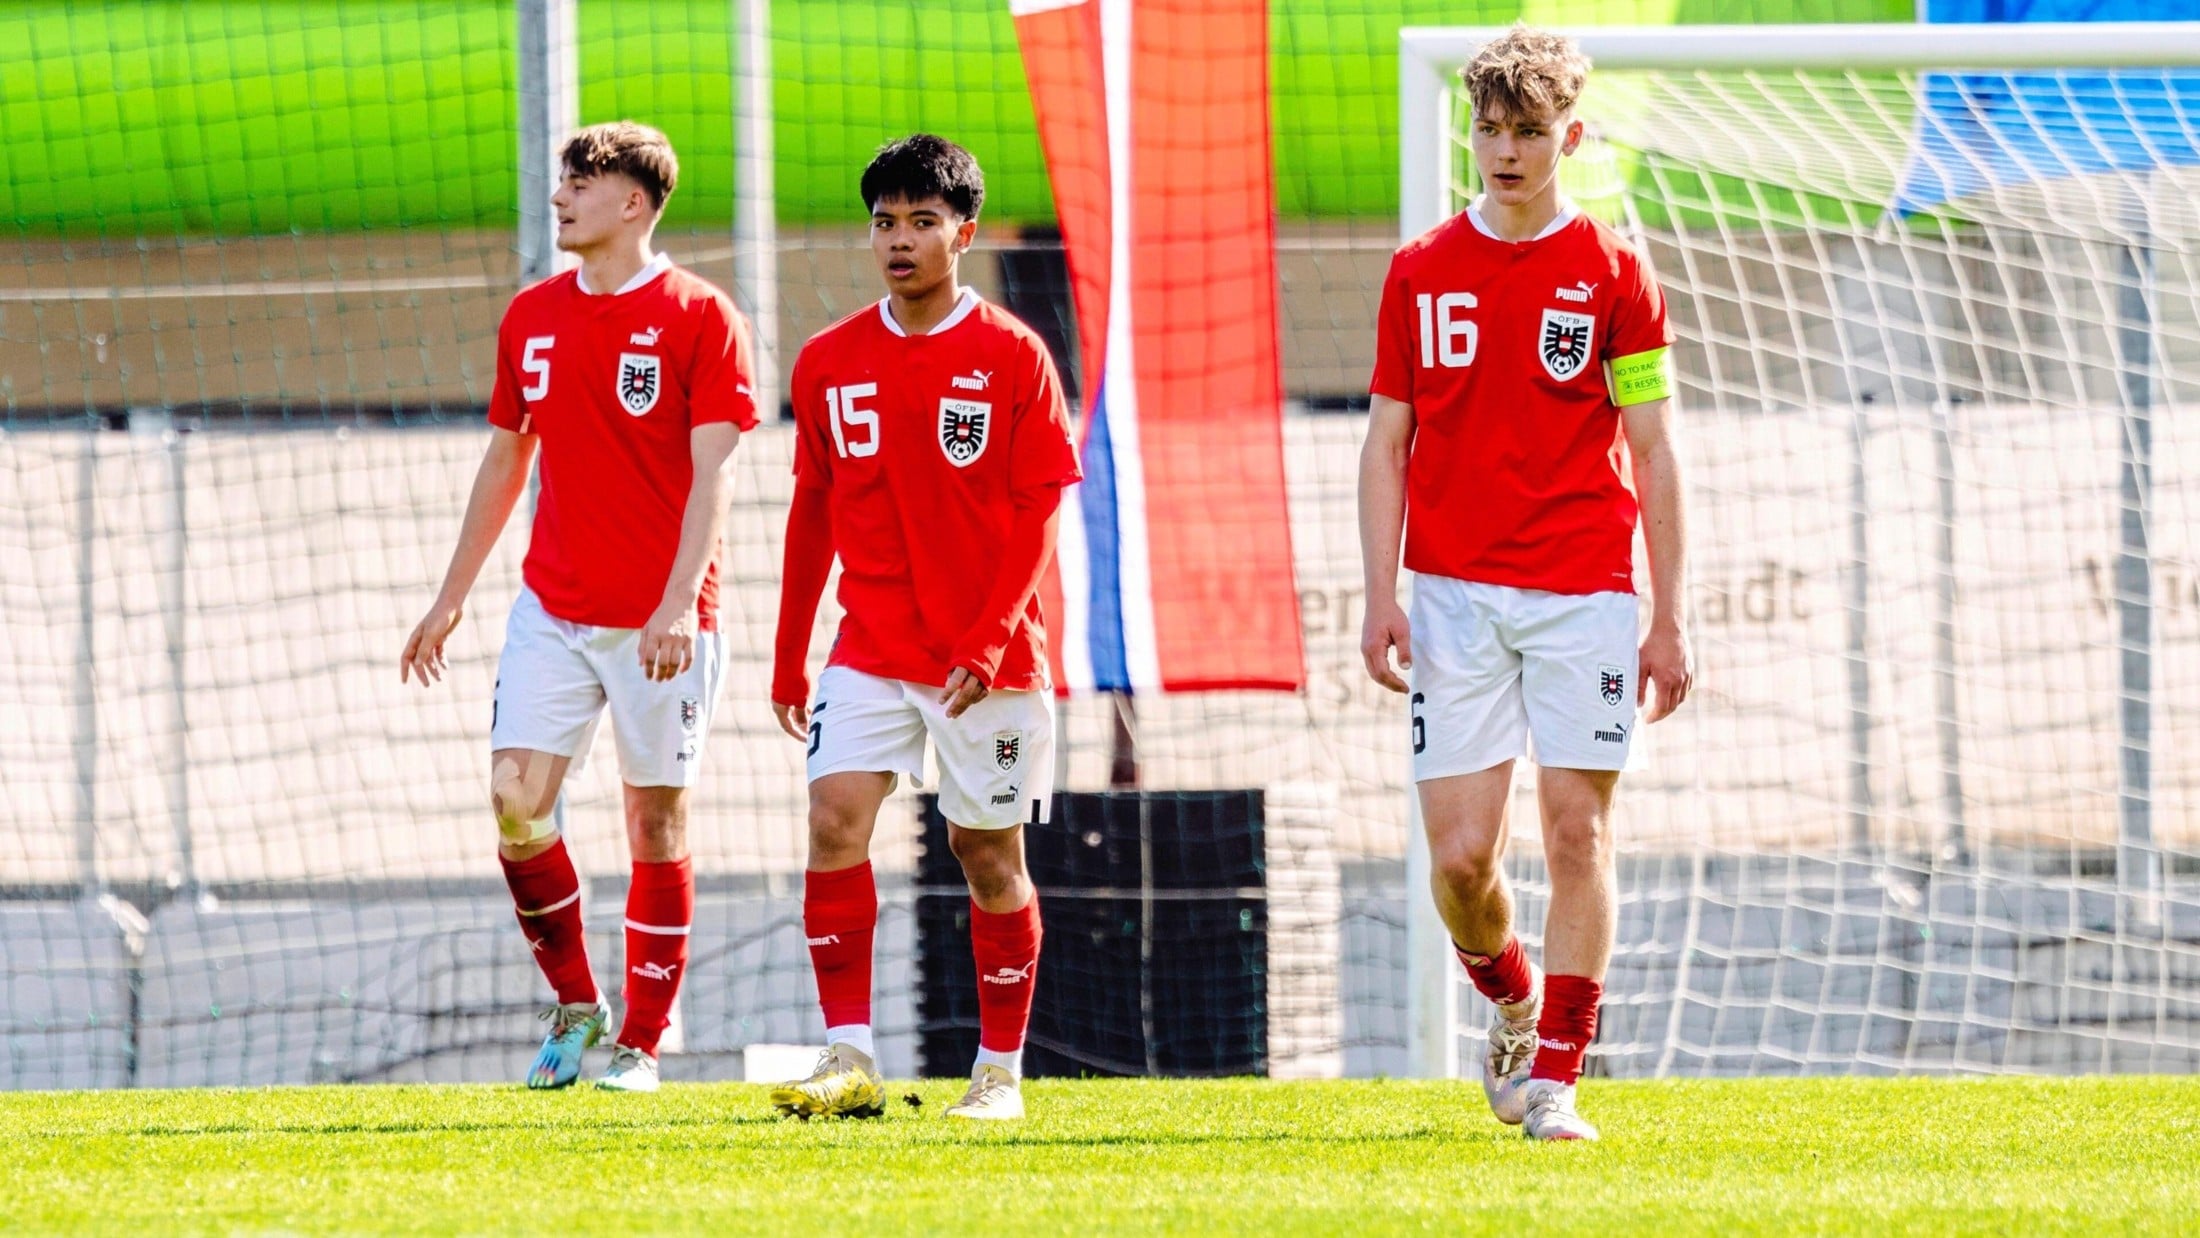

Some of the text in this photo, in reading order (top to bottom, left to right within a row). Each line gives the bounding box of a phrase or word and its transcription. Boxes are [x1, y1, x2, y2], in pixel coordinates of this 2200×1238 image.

[1555, 287, 1588, 303] PUMA
[1557, 314, 1581, 325] ÖFB
[1416, 292, 1478, 368] 16
[521, 335, 555, 402] 5
[1615, 368, 1627, 377] NO
[1628, 366, 1640, 375] TO
[951, 376, 984, 391] PUMA
[954, 403, 977, 412] ÖFB
[826, 382, 879, 458] 15
[1594, 730, 1624, 744] PUMA
[991, 793, 1016, 805] PUMA
[631, 965, 663, 981] PUMA
[983, 974, 1021, 985] PUMA
